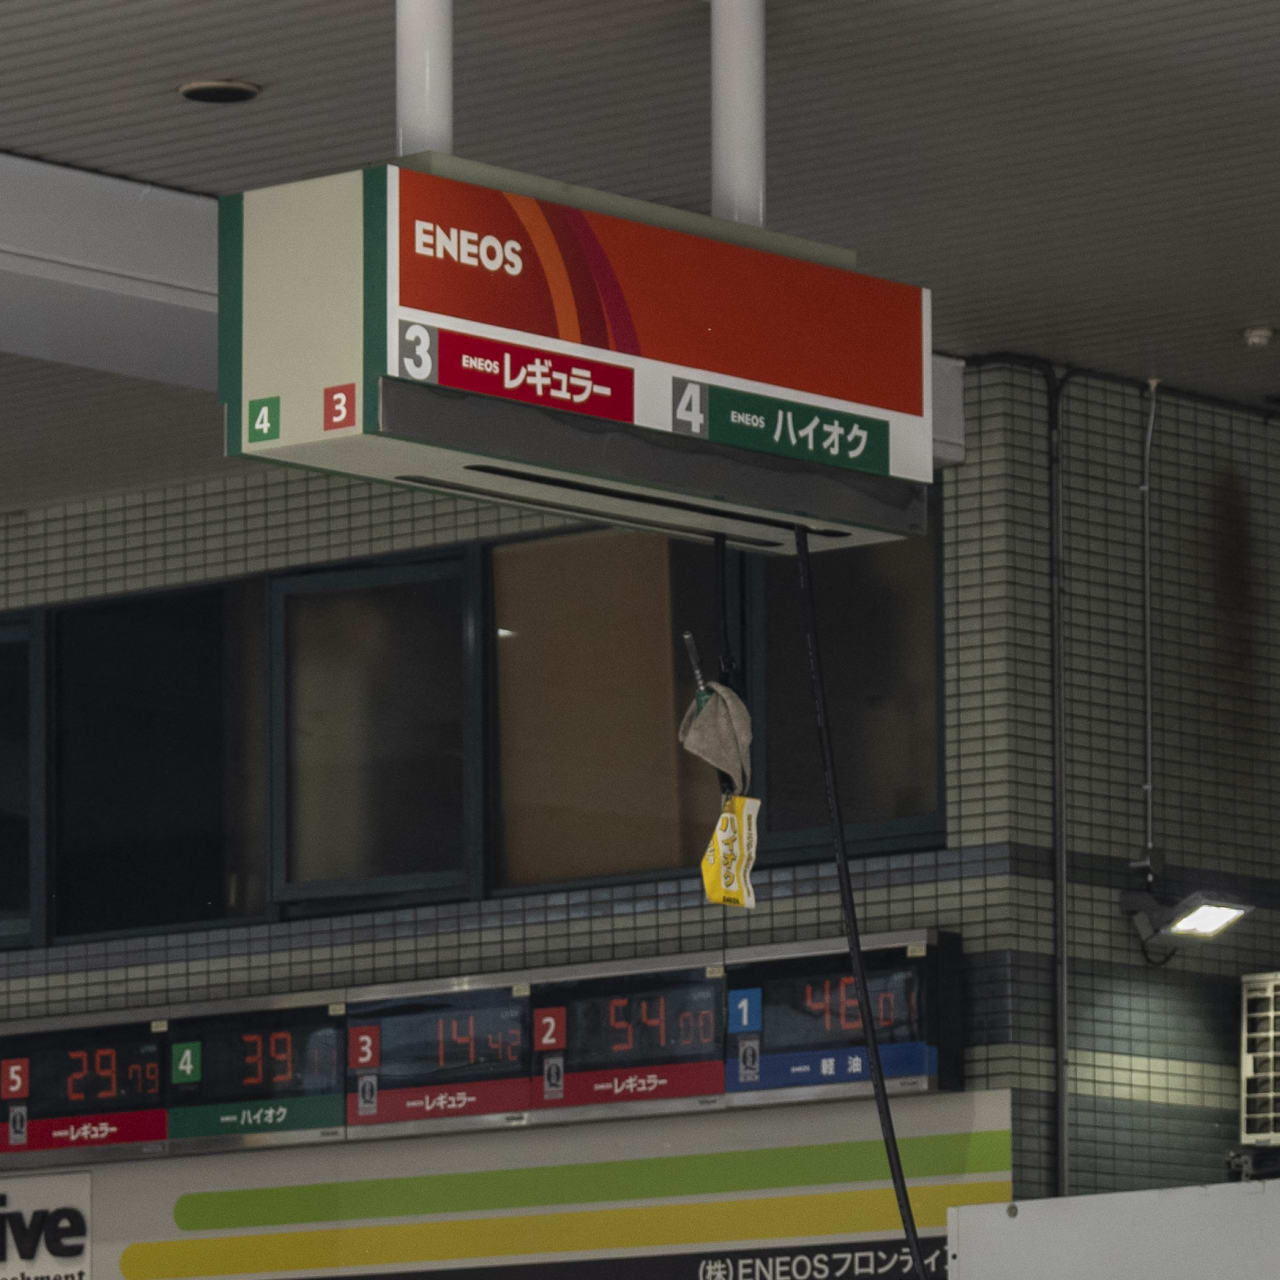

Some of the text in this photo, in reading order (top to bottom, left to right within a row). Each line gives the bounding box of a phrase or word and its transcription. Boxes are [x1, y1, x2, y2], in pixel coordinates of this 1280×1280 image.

[415, 220, 523, 277] ENEOS
[403, 324, 432, 380] 3
[462, 353, 612, 403] ENEOS レギュラー
[255, 406, 271, 433] 4
[333, 392, 347, 422] 3
[676, 383, 705, 434] 4
[731, 410, 869, 460] ENEOS ハイオク
[720, 816, 736, 888] ハイオク
[737, 998, 749, 1026] 1
[541, 1017, 557, 1044] 2
[177, 1049, 193, 1075] 4
[358, 1035, 373, 1063] 3
[8, 1065, 22, 1092] 5
[612, 1074, 668, 1094] レギュラー
[423, 1091, 476, 1111] レギュラー
[240, 1106, 288, 1125] ハイオク
[68, 1121, 117, 1141] レギュラー
